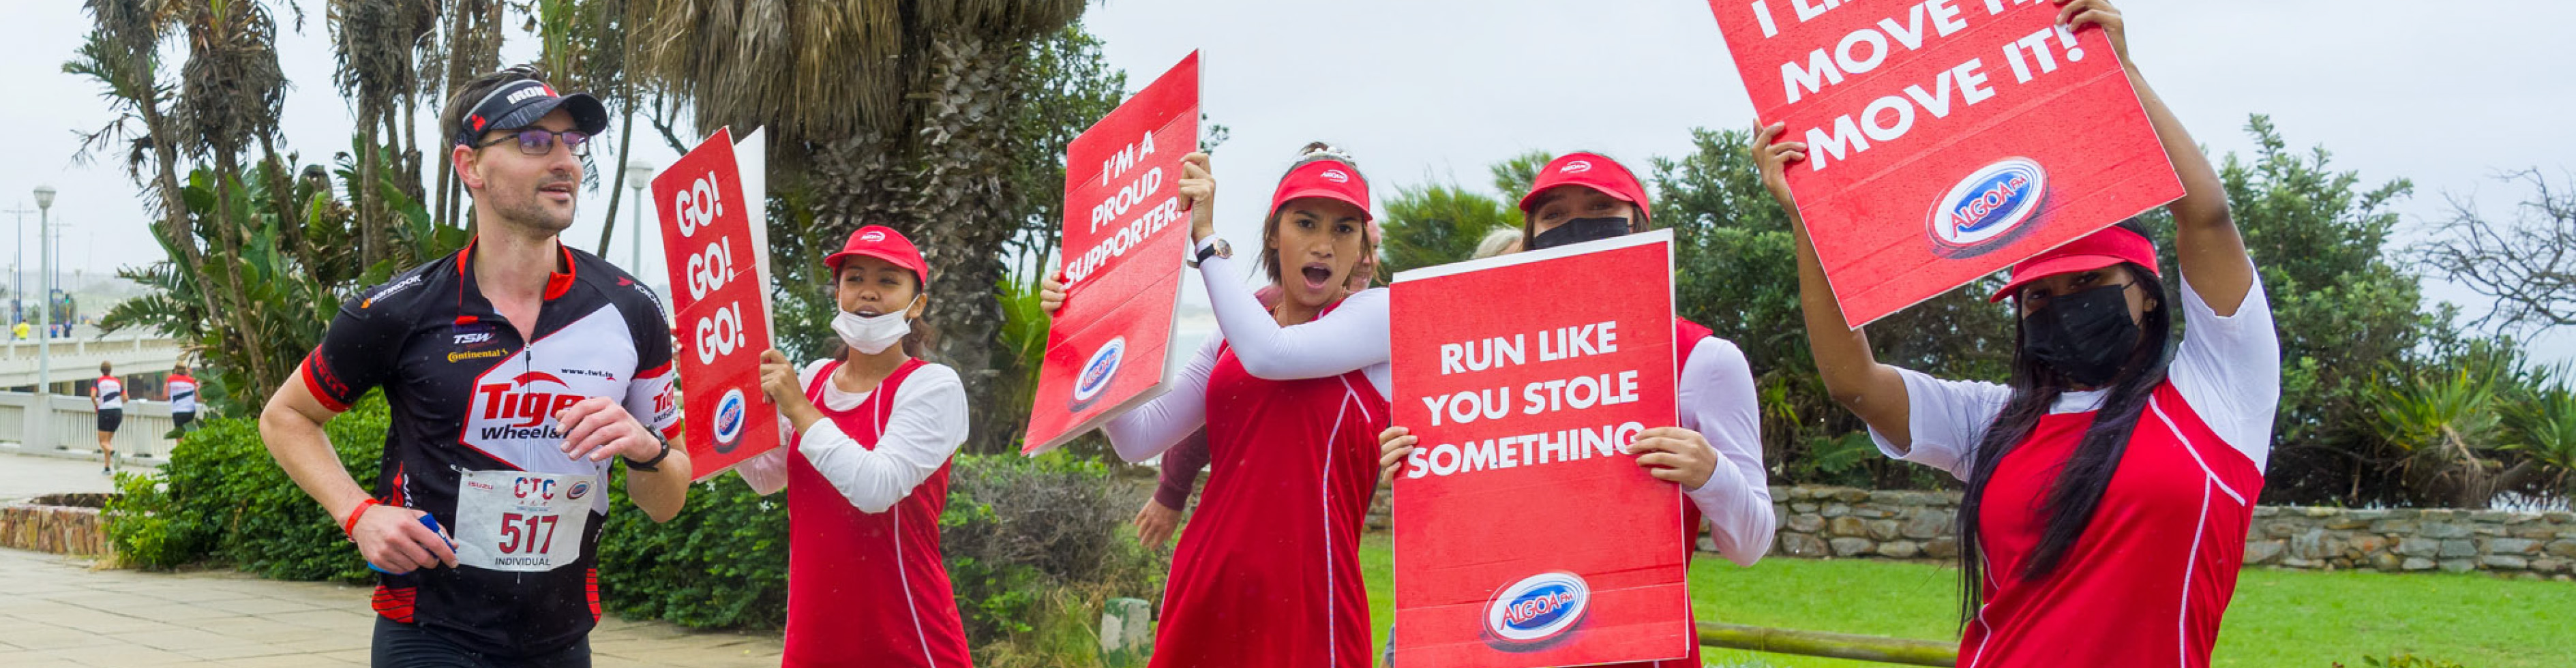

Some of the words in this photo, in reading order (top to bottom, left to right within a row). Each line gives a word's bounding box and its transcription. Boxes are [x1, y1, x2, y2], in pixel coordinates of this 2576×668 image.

[1780, 0, 1968, 105] MOVE
[1806, 57, 1996, 172] MOVE
[2002, 24, 2084, 85] IT!
[1103, 142, 1134, 187] I'M
[1138, 130, 1154, 162] A
[676, 170, 723, 238] GO!
[1091, 166, 1162, 234] PROUD
[1951, 181, 2016, 239] ALGOA
[2009, 175, 2027, 191] FM
[687, 236, 734, 301] GO!
[447, 348, 501, 363] Continental
[696, 301, 745, 365] GO!
[1441, 334, 1525, 375] RUN
[1539, 321, 1617, 362] LIKE
[480, 382, 596, 427] Tige
[1422, 386, 1510, 427] YOU
[1523, 370, 1639, 415] STOLE
[1407, 421, 1646, 479] SOMETHING
[514, 476, 556, 500] CTC
[494, 557, 551, 566] INDIVIDUAL
[498, 512, 559, 554] 517
[1499, 591, 1561, 631] ALGOA
[1559, 592, 1574, 604] FM
